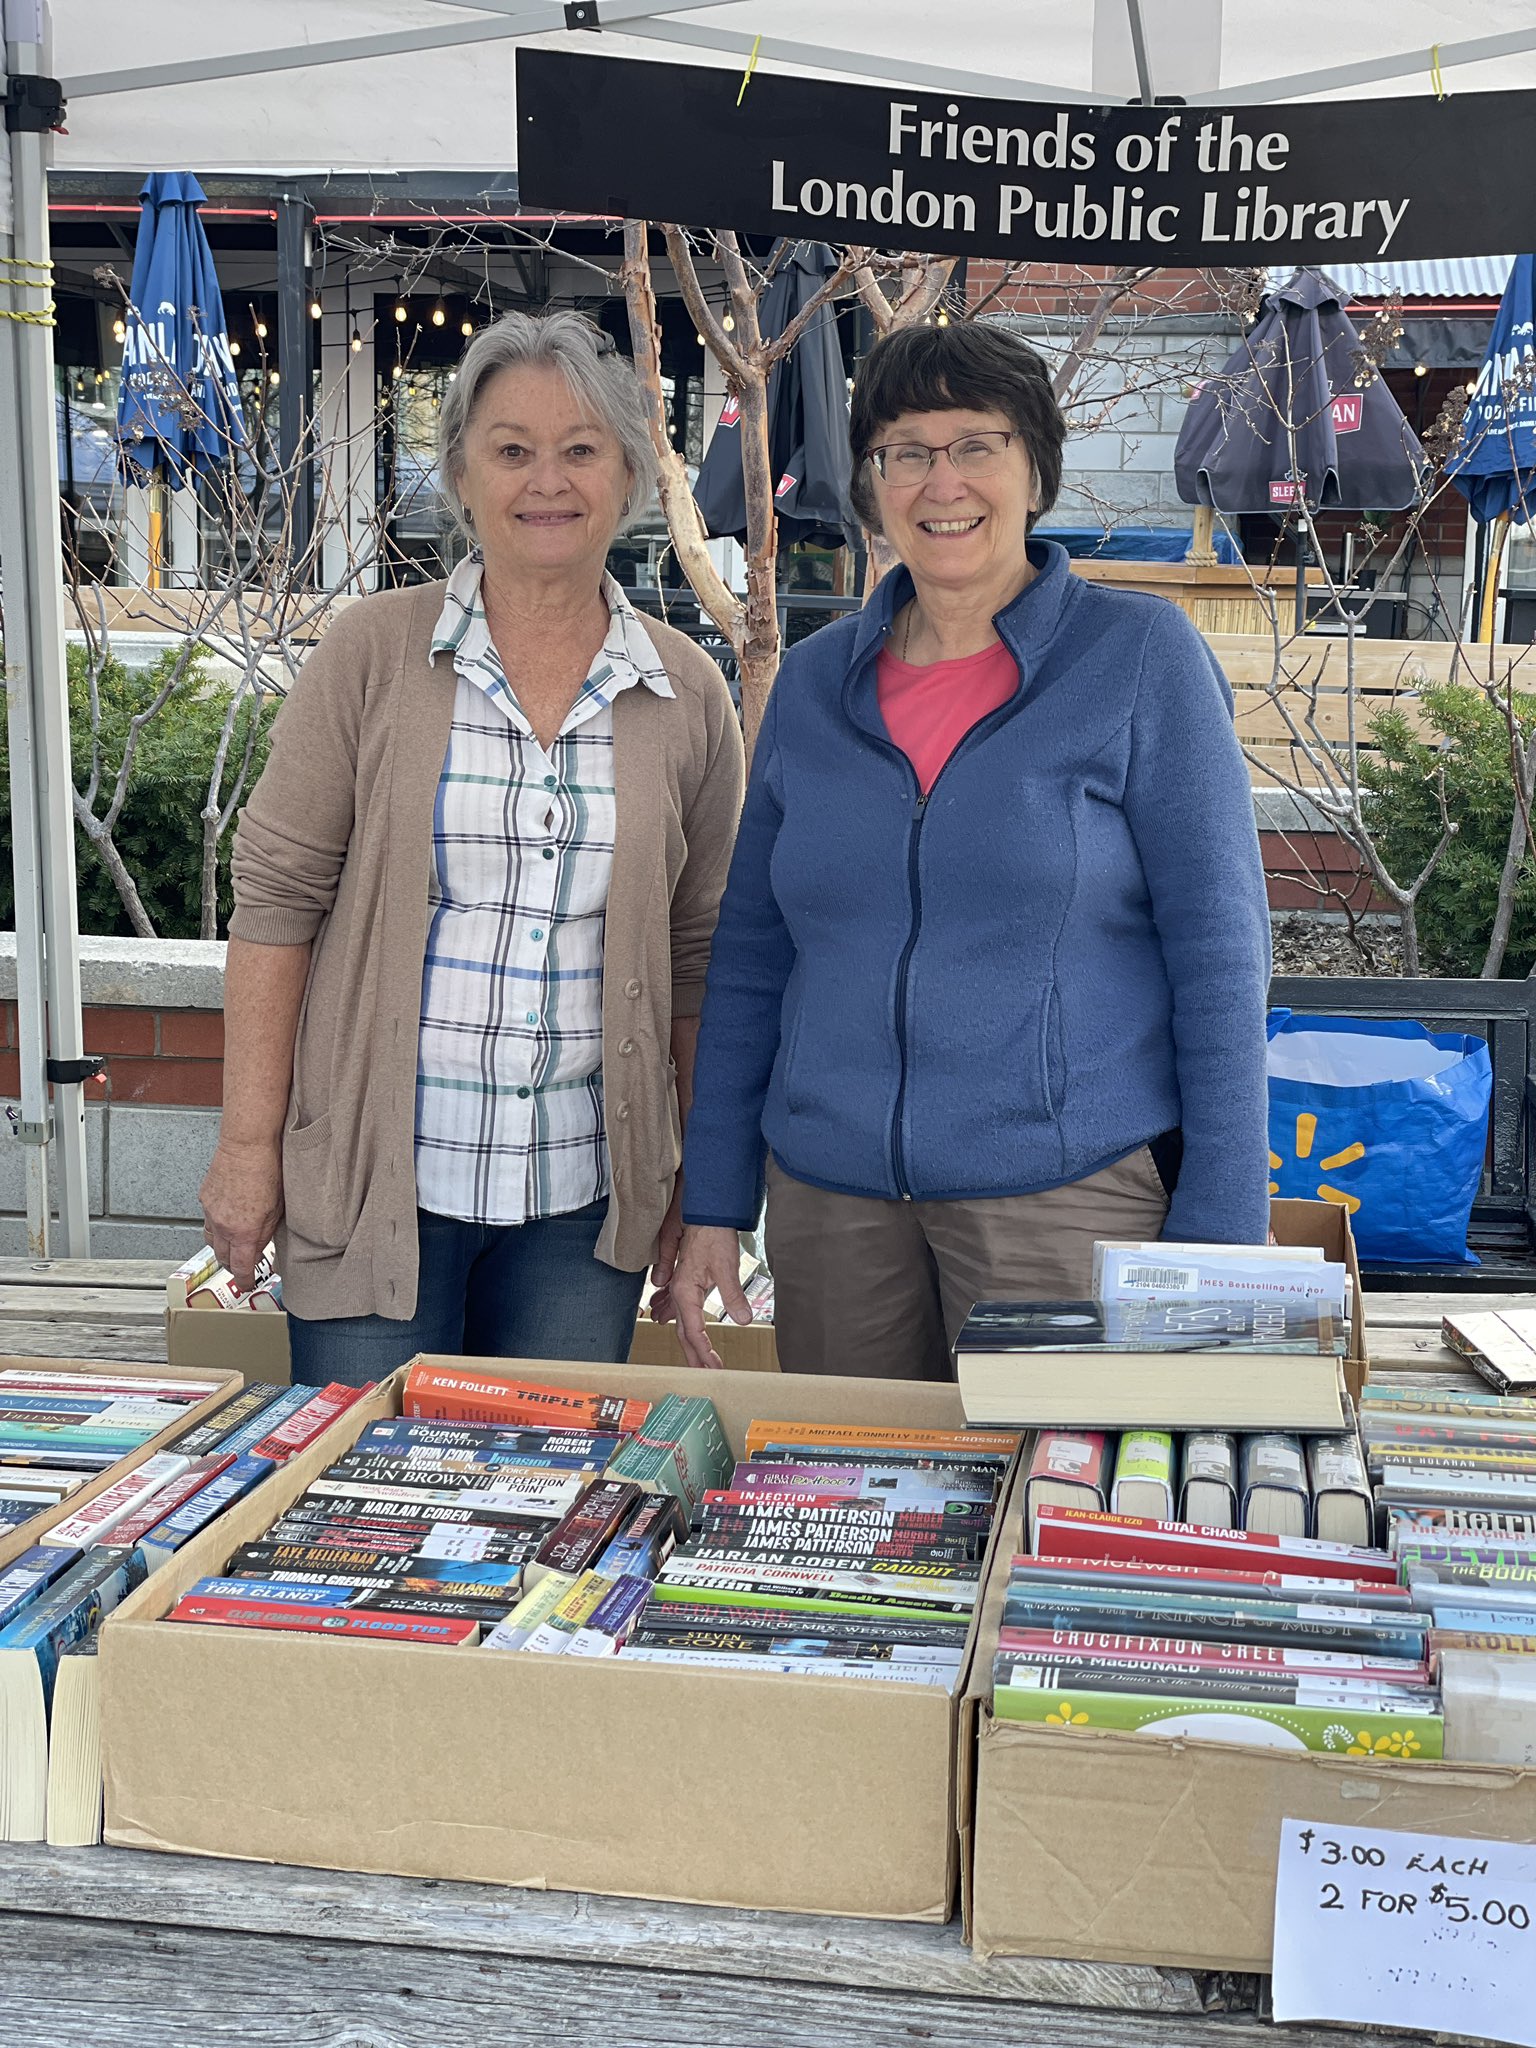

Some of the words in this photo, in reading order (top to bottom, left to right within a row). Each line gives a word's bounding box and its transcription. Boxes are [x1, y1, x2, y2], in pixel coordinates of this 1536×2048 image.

[889, 103, 1095, 170] Friends
[1115, 116, 1177, 172] of
[1196, 116, 1289, 172] the
[771, 160, 976, 232] London
[998, 184, 1178, 242] Public
[1201, 185, 1409, 255] Library
[1332, 402, 1356, 423] AN
[1200, 1280, 1224, 1288] IMES
[1228, 1281, 1285, 1293] Bestselling
[1163, 1307, 1232, 1333] SEA
[432, 1376, 458, 1389] KEN
[459, 1380, 510, 1397] FOLLETT
[516, 1390, 585, 1409] TRIPLE
[25, 1399, 98, 1410] FIELDING
[3, 1411, 77, 1423] FIELDING
[407, 1428, 471, 1440] BOURNE
[419, 1436, 484, 1447] IDENTITY
[546, 1437, 596, 1448] ROBERT
[808, 1428, 853, 1438] MICHAEL
[856, 1431, 910, 1439] CONNELLY
[954, 1435, 1015, 1445] CROSSING
[405, 1446, 445, 1460] ROBIN
[443, 1449, 480, 1463] COOK
[489, 1452, 552, 1467] Invasion
[541, 1444, 592, 1455] LUDLUM
[464, 1463, 482, 1471] NET
[500, 1465, 530, 1475] FORCE
[938, 1464, 969, 1472] LAST
[971, 1465, 998, 1473] MAN
[1385, 1455, 1414, 1465] CATE
[1419, 1457, 1476, 1468] HOLAHAN
[351, 1468, 400, 1481] DAN
[401, 1471, 476, 1486] BROWN
[496, 1474, 566, 1488] DECEPTION
[846, 1477, 857, 1486] 7
[200, 1474, 248, 1500] JAMES
[507, 1484, 547, 1494] POINT
[740, 1491, 816, 1502] INJECTION
[70, 1491, 136, 1525] PATTERSON
[163, 1493, 226, 1531] PATTERSON
[361, 1500, 421, 1517] HARLAN
[421, 1507, 474, 1522] COBEN
[576, 1499, 602, 1518] HOAG
[738, 1504, 796, 1520] JAMES
[799, 1507, 895, 1528] PATTERSON
[352, 1518, 429, 1531] EXECUTIONER
[898, 1512, 945, 1523] MURDER
[1064, 1509, 1123, 1524] JEAN-CLAUDE
[1124, 1516, 1143, 1526] IZZO
[1156, 1519, 1198, 1535] TOTAL
[1200, 1526, 1248, 1541] CHAOS
[748, 1519, 801, 1538] JAMES
[804, 1522, 893, 1543] PATTERSON
[893, 1530, 937, 1541] MURDER
[1411, 1525, 1441, 1535] THE
[1448, 1528, 1526, 1541] WATCHER
[548, 1541, 572, 1558] ACTS
[742, 1535, 791, 1551] JAMES
[793, 1538, 875, 1555] PATTERSON
[273, 1545, 303, 1560] FAYE
[304, 1548, 378, 1564] KELLERMAN
[695, 1549, 785, 1564] HARLAN
[790, 1555, 866, 1571] COBEN
[871, 1562, 955, 1577] CAUGHT
[269, 1557, 294, 1566] THE
[293, 1559, 370, 1572] FORGOTTEN
[696, 1563, 756, 1576] PATRICIA
[762, 1569, 835, 1582] CORNWELL
[1083, 1558, 1199, 1575] McEwan
[1451, 1565, 1479, 1576] THE
[268, 1570, 327, 1585] THOMAS
[325, 1575, 394, 1589] GREANIAS
[204, 1585, 246, 1595] TOM
[249, 1588, 327, 1601] CLANCY
[662, 1573, 753, 1592] Griffin
[828, 1591, 882, 1603] Deadly
[885, 1597, 937, 1608] Assets
[380, 1603, 470, 1614] GREANEY
[413, 1600, 466, 1610] MARK
[661, 1603, 720, 1617] RUTH
[727, 1607, 793, 1622] WARE
[226, 1609, 263, 1620] CLIVE
[263, 1612, 322, 1624] CUSSLER
[350, 1619, 409, 1632] FLOOD
[411, 1623, 452, 1635] TIDE
[683, 1615, 716, 1624] THE
[719, 1618, 772, 1628] DEATH
[845, 1626, 931, 1638] WESTAWAY
[1134, 1608, 1246, 1628] PRINCE
[1281, 1620, 1352, 1637] MIST
[667, 1637, 753, 1650] GORE
[687, 1631, 742, 1641] STEVEN
[1052, 1630, 1203, 1656] CRUCIFIXION
[1221, 1643, 1286, 1662] CREE
[1005, 1652, 1084, 1665] PATRICIA
[1090, 1656, 1201, 1675] MacDONALD
[842, 1671, 918, 1682] Undertow
[1299, 1829, 1385, 1866] $3.00
[1406, 1853, 1489, 1875] EACH
[1320, 1883, 1344, 1909] 2
[1362, 1889, 1418, 1914] FOR
[1428, 1883, 1530, 1929] $5.00
